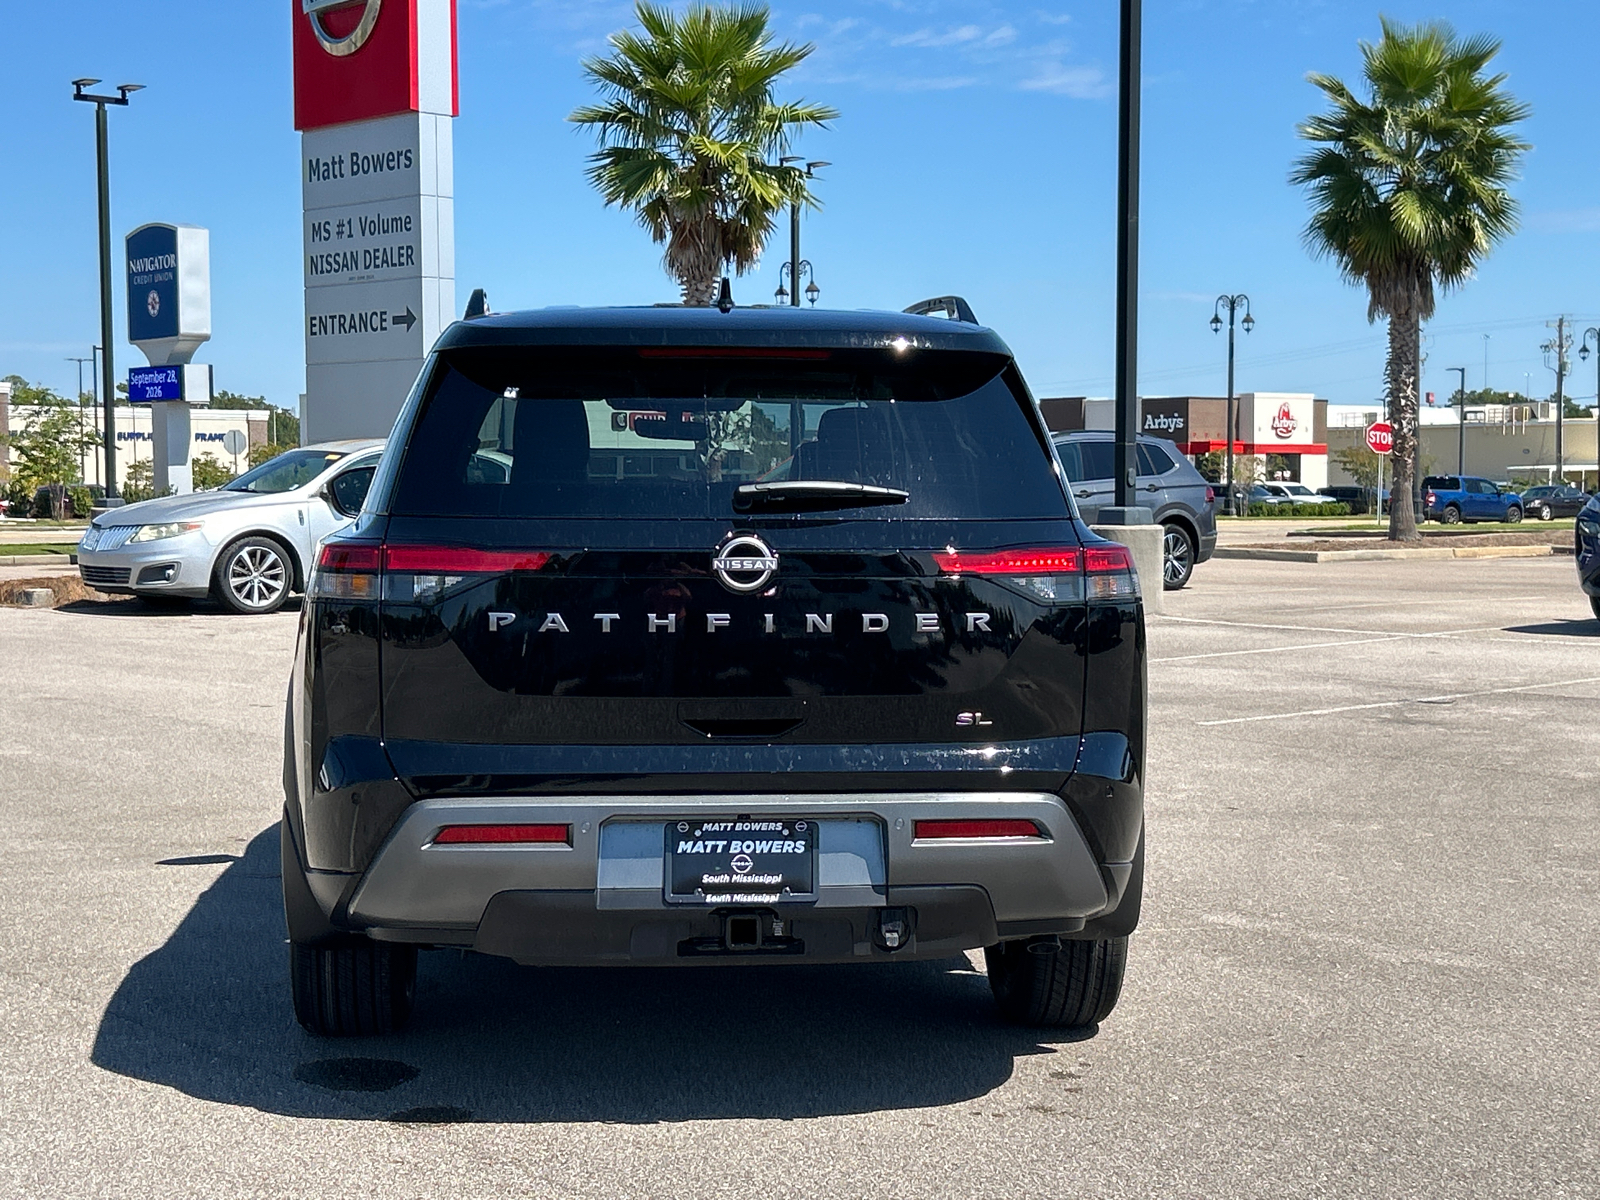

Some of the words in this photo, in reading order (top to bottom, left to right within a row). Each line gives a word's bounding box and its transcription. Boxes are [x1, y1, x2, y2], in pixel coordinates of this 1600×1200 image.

[308, 154, 345, 183] Matt
[350, 148, 413, 177] Bowers
[311, 220, 332, 243] MS
[336, 218, 354, 240] #1
[359, 213, 412, 237] Volume
[129, 253, 177, 274] NAVIGATOR
[310, 250, 359, 276] NISSAN
[363, 245, 415, 271] DEALER
[133, 274, 153, 286] CREDIT
[154, 271, 174, 283] UNION
[309, 310, 388, 337] ENTRANCE
[130, 370, 166, 388] September
[167, 369, 178, 384] 28,
[145, 385, 163, 398] 2026
[1143, 413, 1185, 433] Arby's
[713, 560, 776, 569] NISSAN
[487, 611, 993, 634] PATHFINDER
[955, 711, 993, 726] SL
[702, 822, 734, 832] MATT
[735, 822, 783, 832] BOWERS
[677, 840, 728, 854] MATT
[729, 840, 806, 854] BOWERS
[702, 874, 730, 884] South
[731, 873, 783, 885] Mississippi
[705, 893, 731, 903] South
[732, 893, 780, 904] Mississippi
